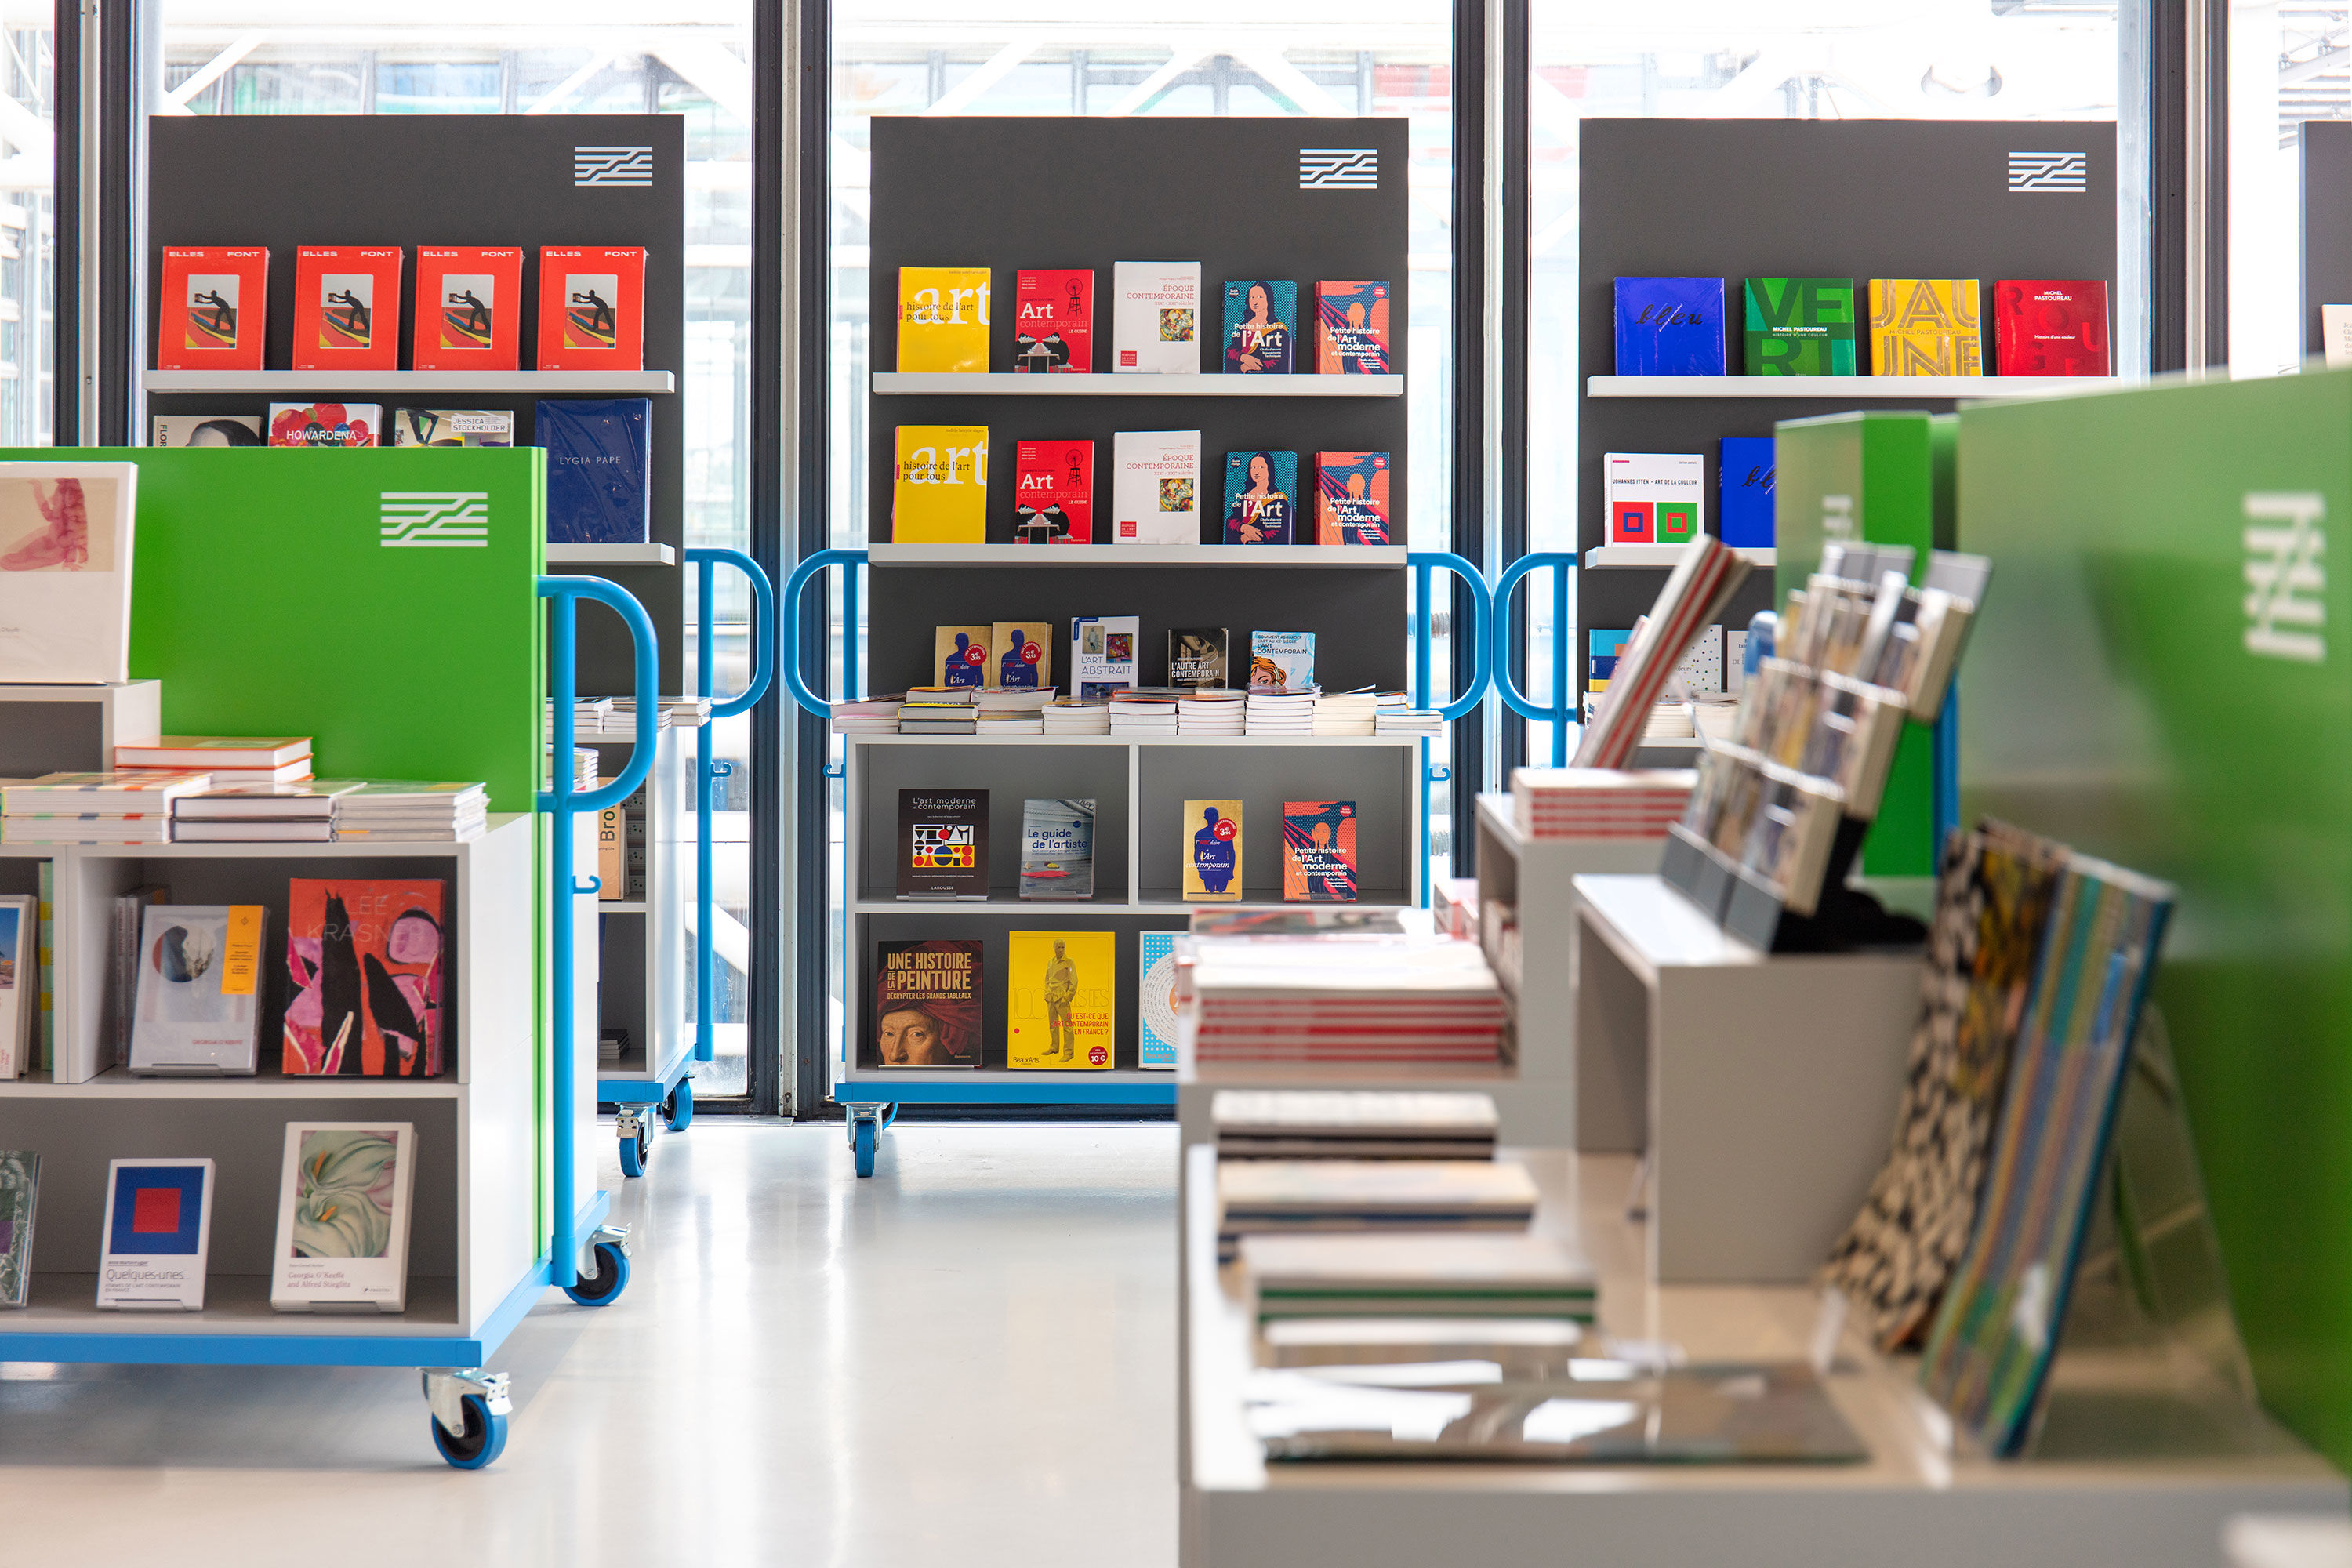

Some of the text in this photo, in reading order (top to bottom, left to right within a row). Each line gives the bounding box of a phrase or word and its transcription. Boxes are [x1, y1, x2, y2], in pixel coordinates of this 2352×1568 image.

[906, 302, 940, 310] histoire
[913, 282, 990, 325] art
[1020, 303, 1053, 318] Art
[1635, 304, 1703, 325] bleu
[1020, 318, 1087, 329] contemporain
[1243, 331, 1282, 347] l'Art
[287, 430, 356, 440] HOWARDENA
[904, 461, 937, 470] histoire
[953, 462, 970, 470] l'art
[909, 441, 987, 485] art
[903, 474, 924, 482] pour
[1020, 474, 1053, 489] Art
[1020, 489, 1087, 500] contemporain
[1243, 500, 1283, 517] l'Art
[1082, 666, 1132, 674] ABSTRAIT
[1028, 829, 1072, 840] Le guide
[1033, 839, 1087, 848] de l'artiste
[1185, 861, 1229, 869] contemporain
[345, 896, 387, 914] LEE
[307, 924, 425, 942] KRASNER
[887, 953, 971, 970] UNE HISTOIRE
[897, 971, 971, 990] PEINTURE
